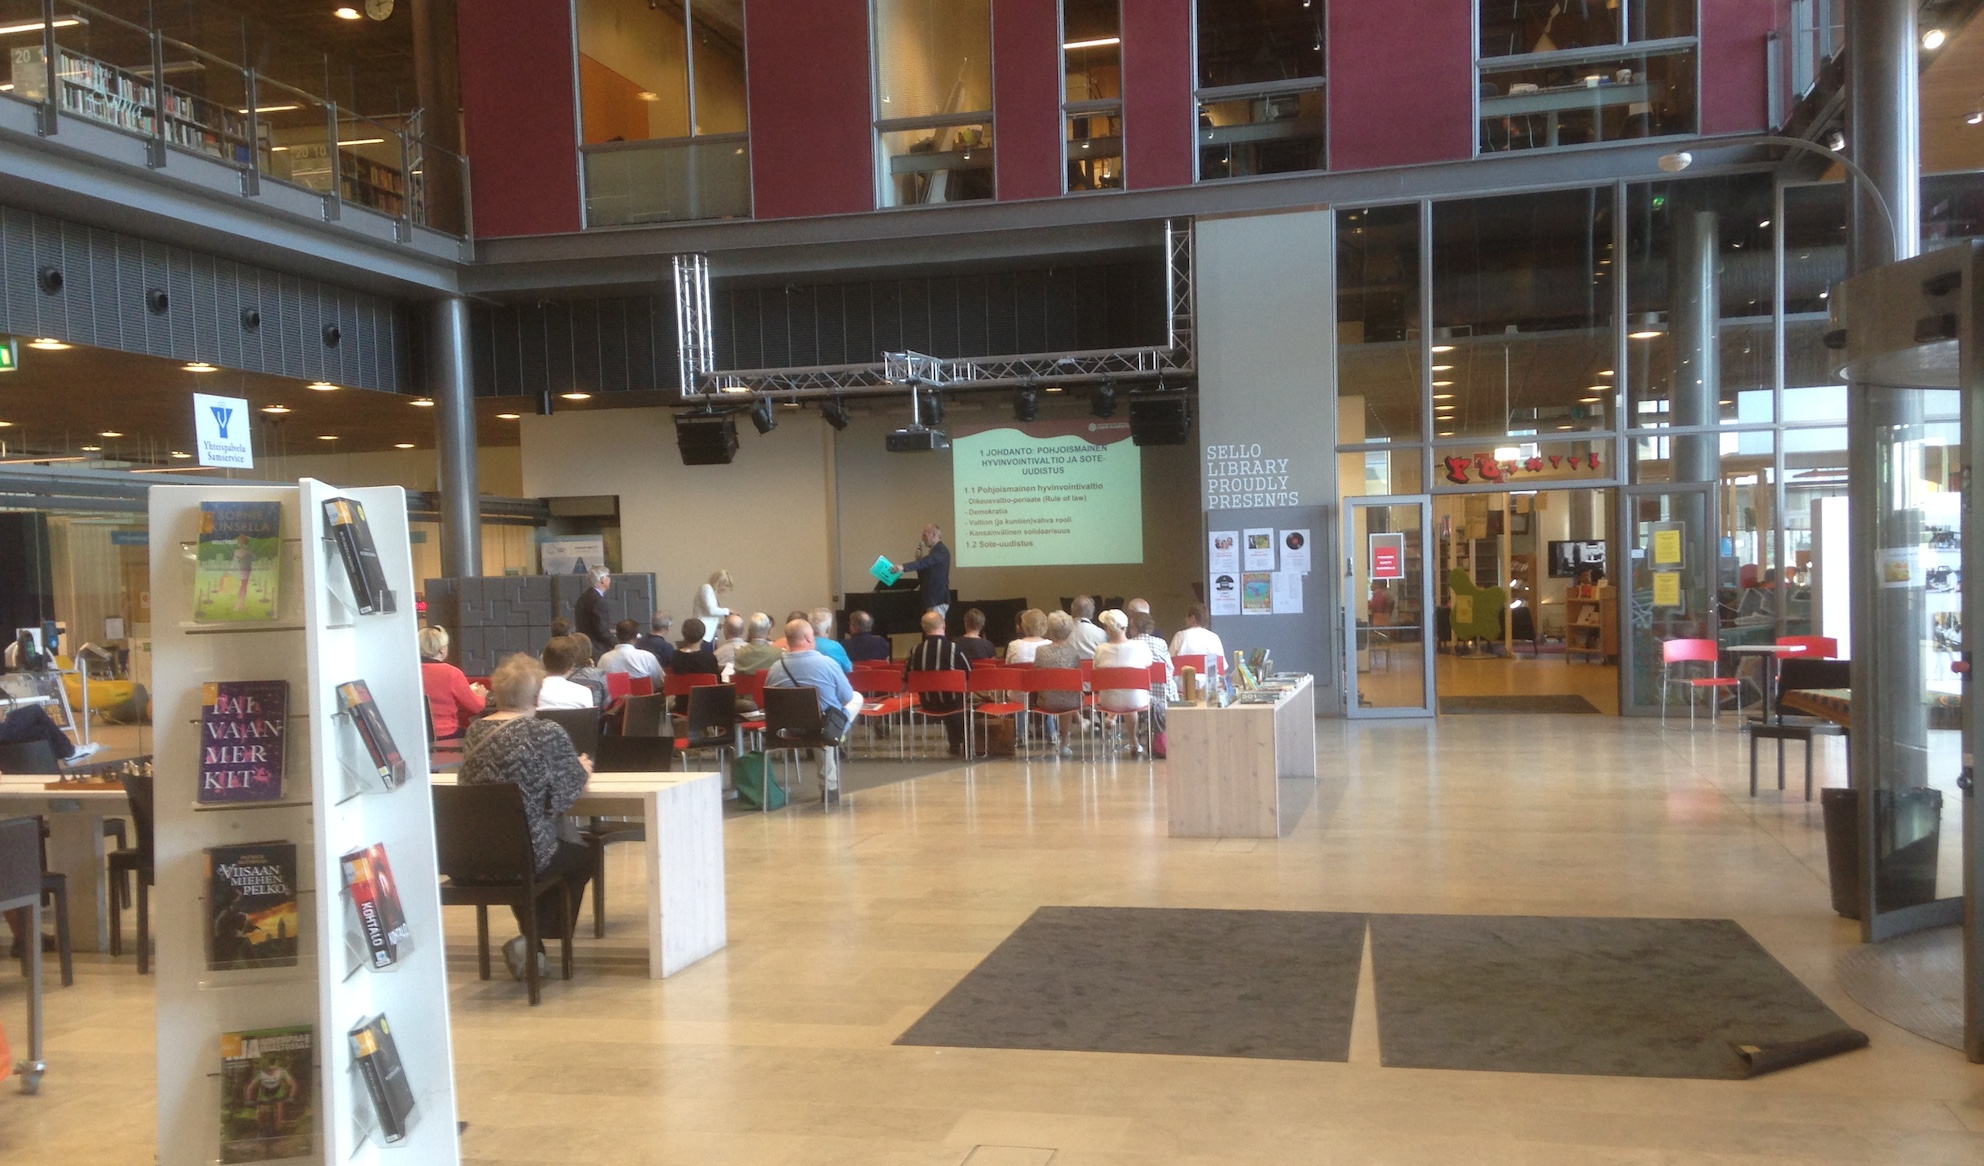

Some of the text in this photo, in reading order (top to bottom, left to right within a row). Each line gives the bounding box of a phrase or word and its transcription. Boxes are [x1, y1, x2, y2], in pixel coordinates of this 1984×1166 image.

[15, 50, 31, 63] 20
[203, 440, 246, 454] Yhteispalvelu
[986, 447, 1035, 457] JOHDANTO:
[1037, 445, 1108, 455] POHJOISMAINEN
[1207, 443, 1261, 460] SELLO
[207, 451, 244, 463] Samservice
[981, 454, 1106, 467] HYVINVOINTIVALTIO JA SOTE-
[1022, 466, 1065, 476] UUDISTUS
[1207, 459, 1289, 477] LIBRARY
[977, 485, 1036, 495] Pohjoismainen
[1037, 482, 1104, 493] hyvinvointivaltio
[1208, 475, 1289, 493] PROUDLY
[1042, 495, 1061, 504] (Rule
[1071, 494, 1087, 503] law)
[1208, 491, 1299, 509] PRESENTS
[978, 539, 1034, 549] Sote-uudistus
[204, 770, 255, 789] KIT
[218, 863, 281, 879] VIISAAN
[230, 875, 283, 886] MIEHEN
[243, 884, 286, 896] PELKO
[361, 901, 384, 946] KOHTALO
